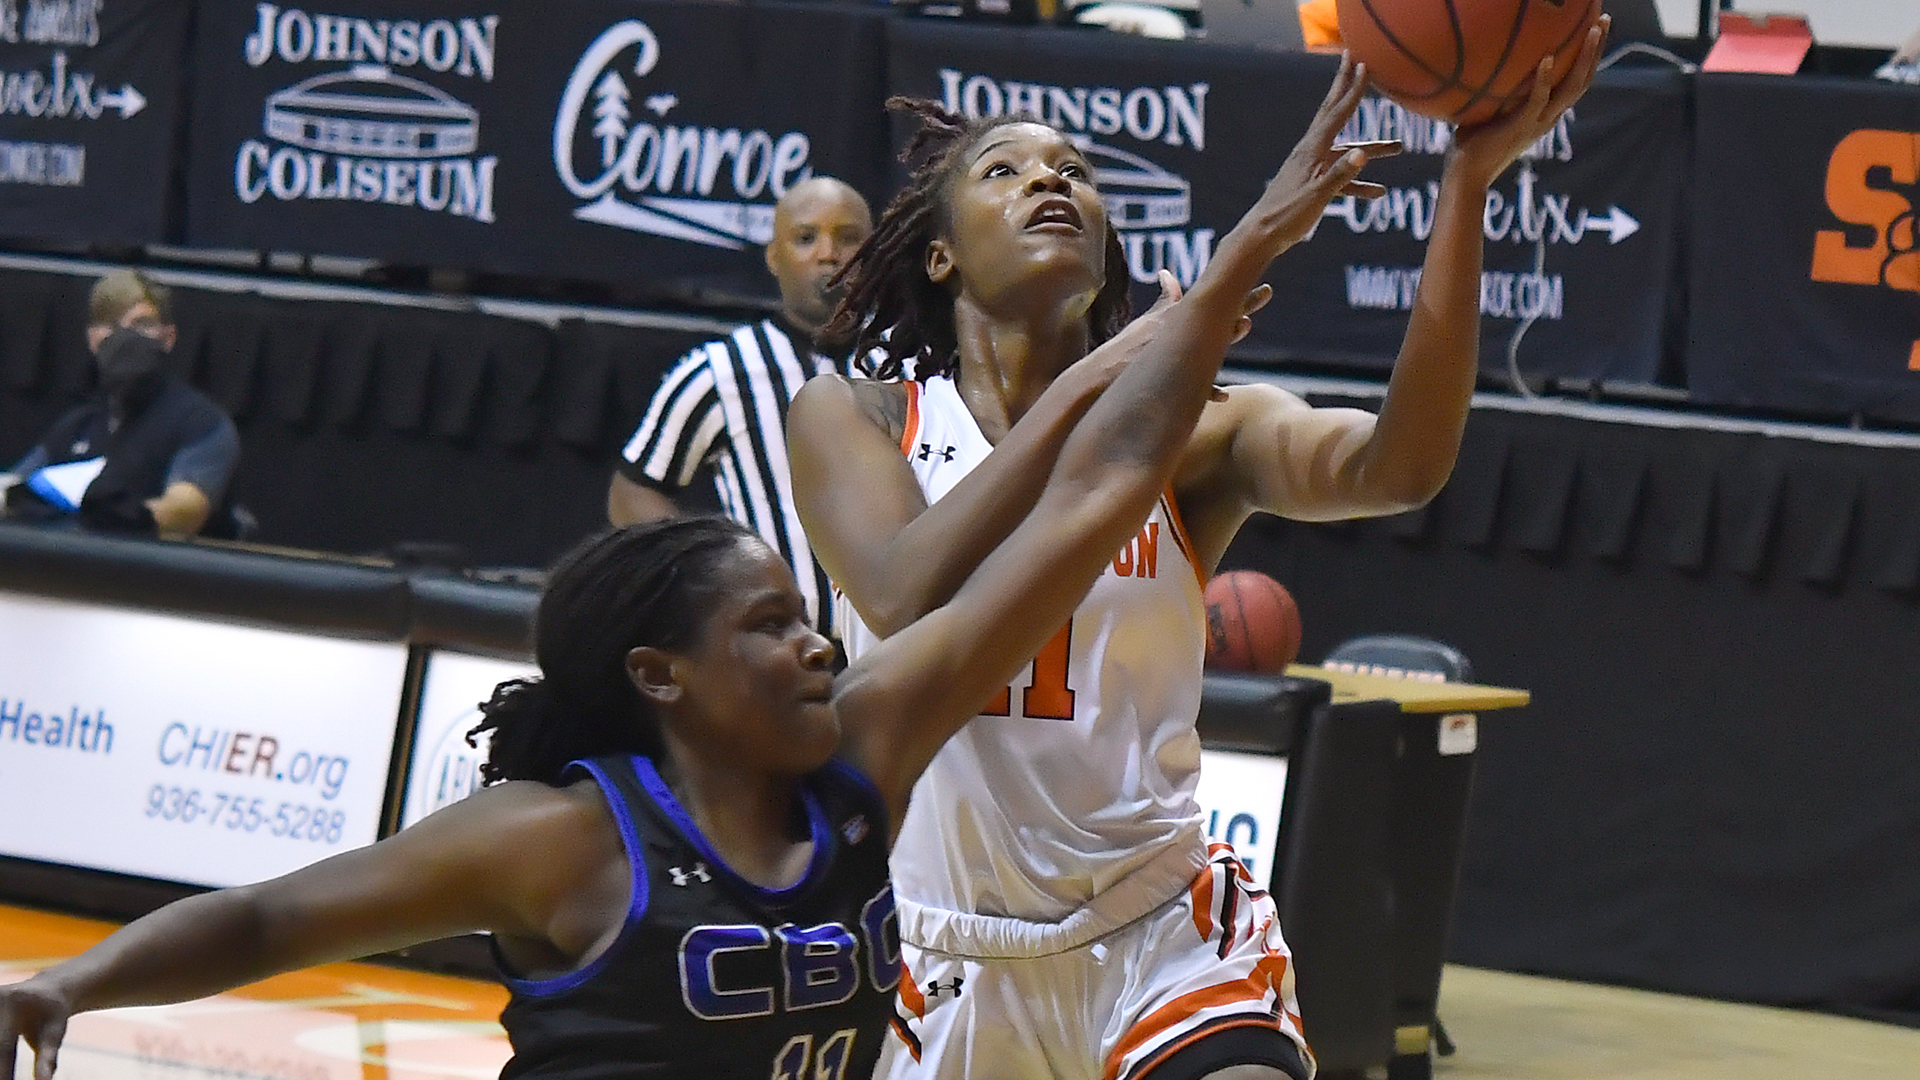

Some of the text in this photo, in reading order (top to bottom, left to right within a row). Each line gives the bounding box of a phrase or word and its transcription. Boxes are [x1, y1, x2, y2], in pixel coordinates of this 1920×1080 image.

[245, 2, 498, 82] JOHNSON
[553, 17, 813, 200] Conroe
[235, 138, 498, 224] COLISEUM
[1112, 522, 1159, 579] ON
[0, 698, 115, 754] Health
[158, 721, 349, 801] CHIER.org
[145, 783, 346, 846] 936-755-5288
